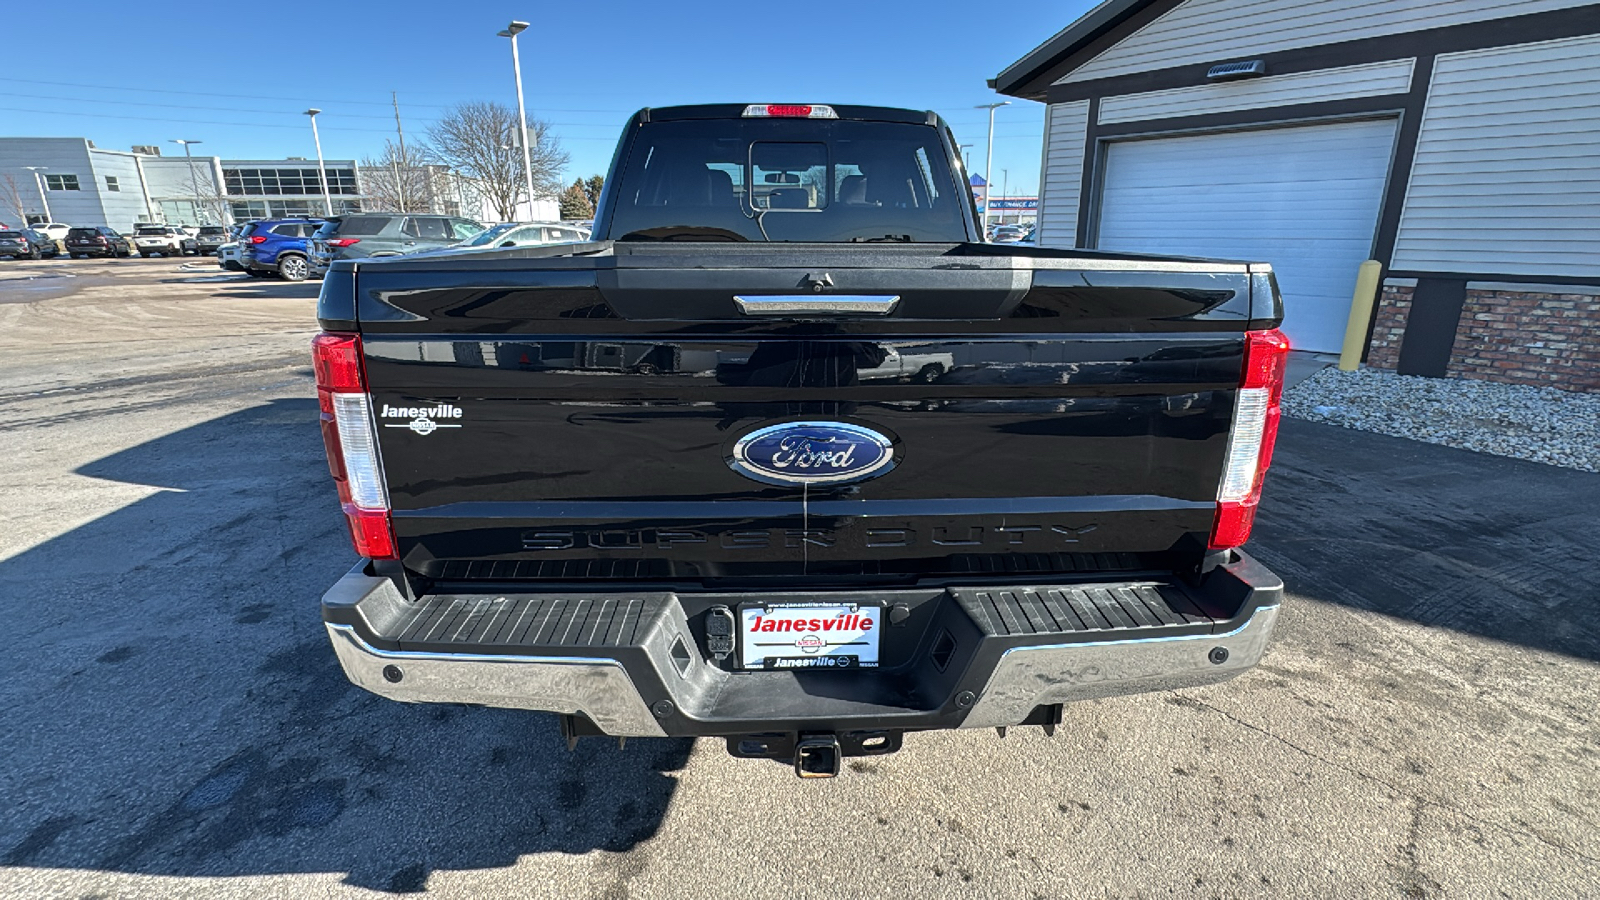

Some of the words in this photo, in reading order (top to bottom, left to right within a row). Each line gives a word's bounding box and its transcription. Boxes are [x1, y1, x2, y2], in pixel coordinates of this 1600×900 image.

[381, 404, 463, 418] Janesville
[772, 435, 857, 468] Ford
[522, 529, 836, 549] SUPER
[866, 524, 1098, 548] DUTY
[750, 614, 874, 632] Janesville
[774, 656, 836, 668] Janesville
